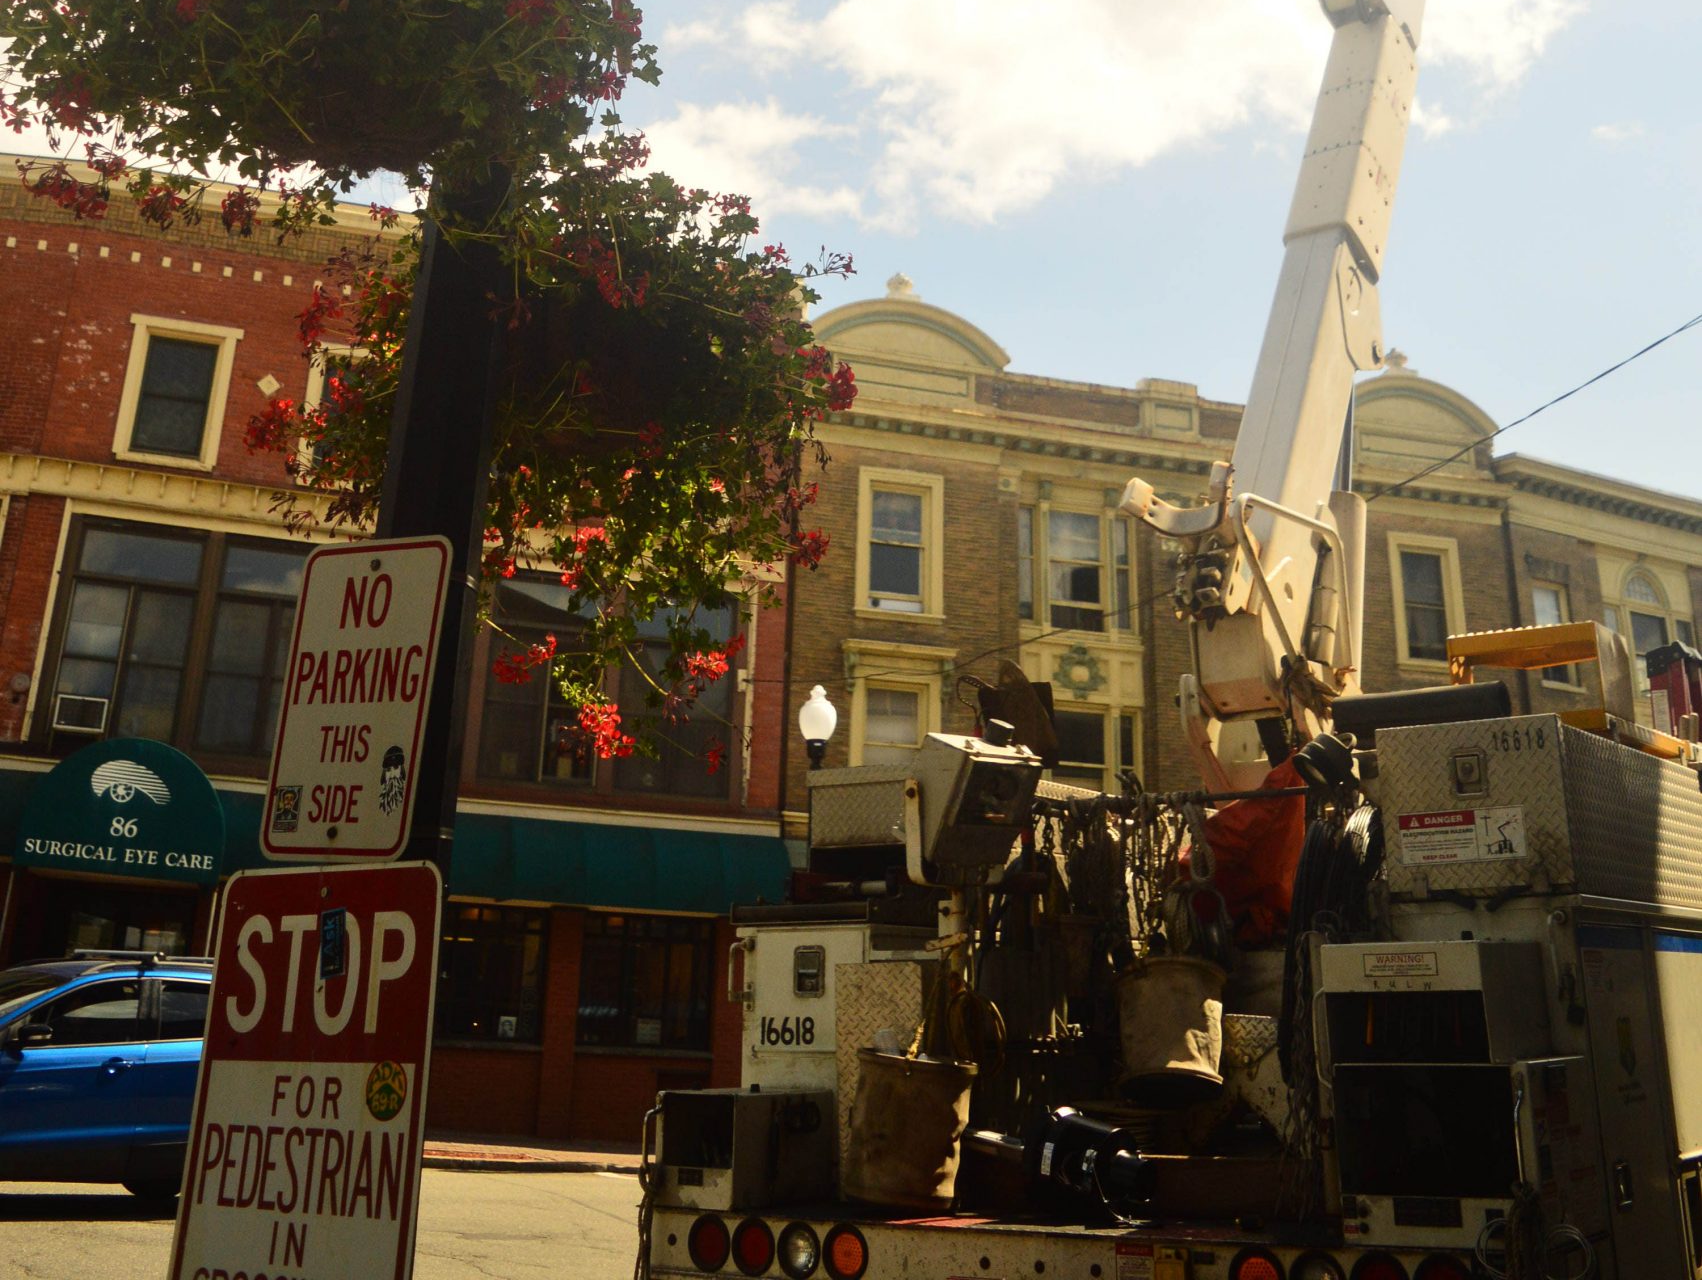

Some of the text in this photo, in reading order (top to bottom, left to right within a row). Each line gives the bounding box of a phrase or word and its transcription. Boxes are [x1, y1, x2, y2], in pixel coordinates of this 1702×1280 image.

[339, 573, 393, 629] NO
[293, 644, 423, 705] PARKING
[319, 724, 372, 763] THIS
[308, 784, 363, 824] SIDE
[1424, 814, 1463, 825] DANGER
[110, 816, 139, 838] 86
[24, 838, 215, 870] SURGICAL EYE CARE
[226, 911, 416, 1036] STOP
[761, 1016, 814, 1046] 16618
[271, 1075, 342, 1120] FOR
[197, 1123, 404, 1221] PEDESTRIAN
[269, 1221, 307, 1268] IN
